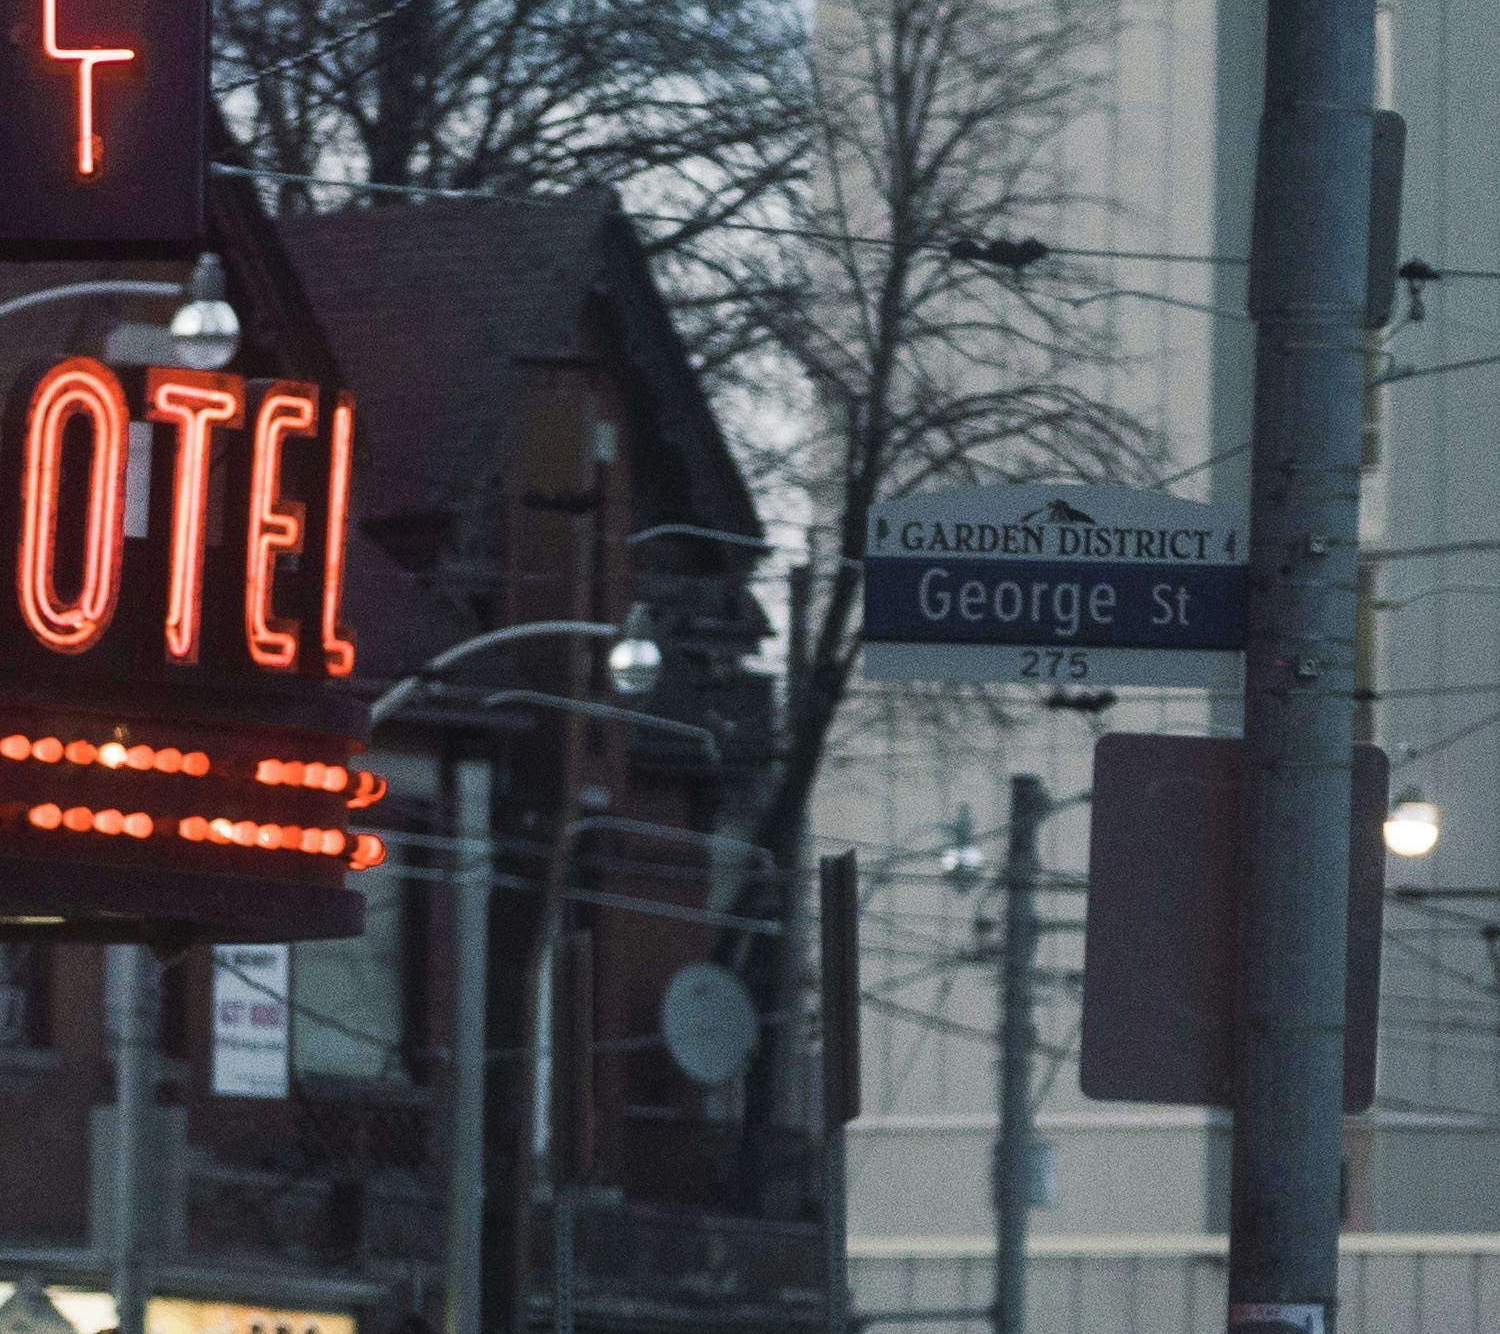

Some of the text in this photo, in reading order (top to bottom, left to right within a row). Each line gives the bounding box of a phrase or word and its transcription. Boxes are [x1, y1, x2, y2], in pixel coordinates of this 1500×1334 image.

[900, 520, 1214, 560] GARDEN DISTRICT
[918, 567, 1191, 637] George St
[1018, 649, 1090, 679] 275
